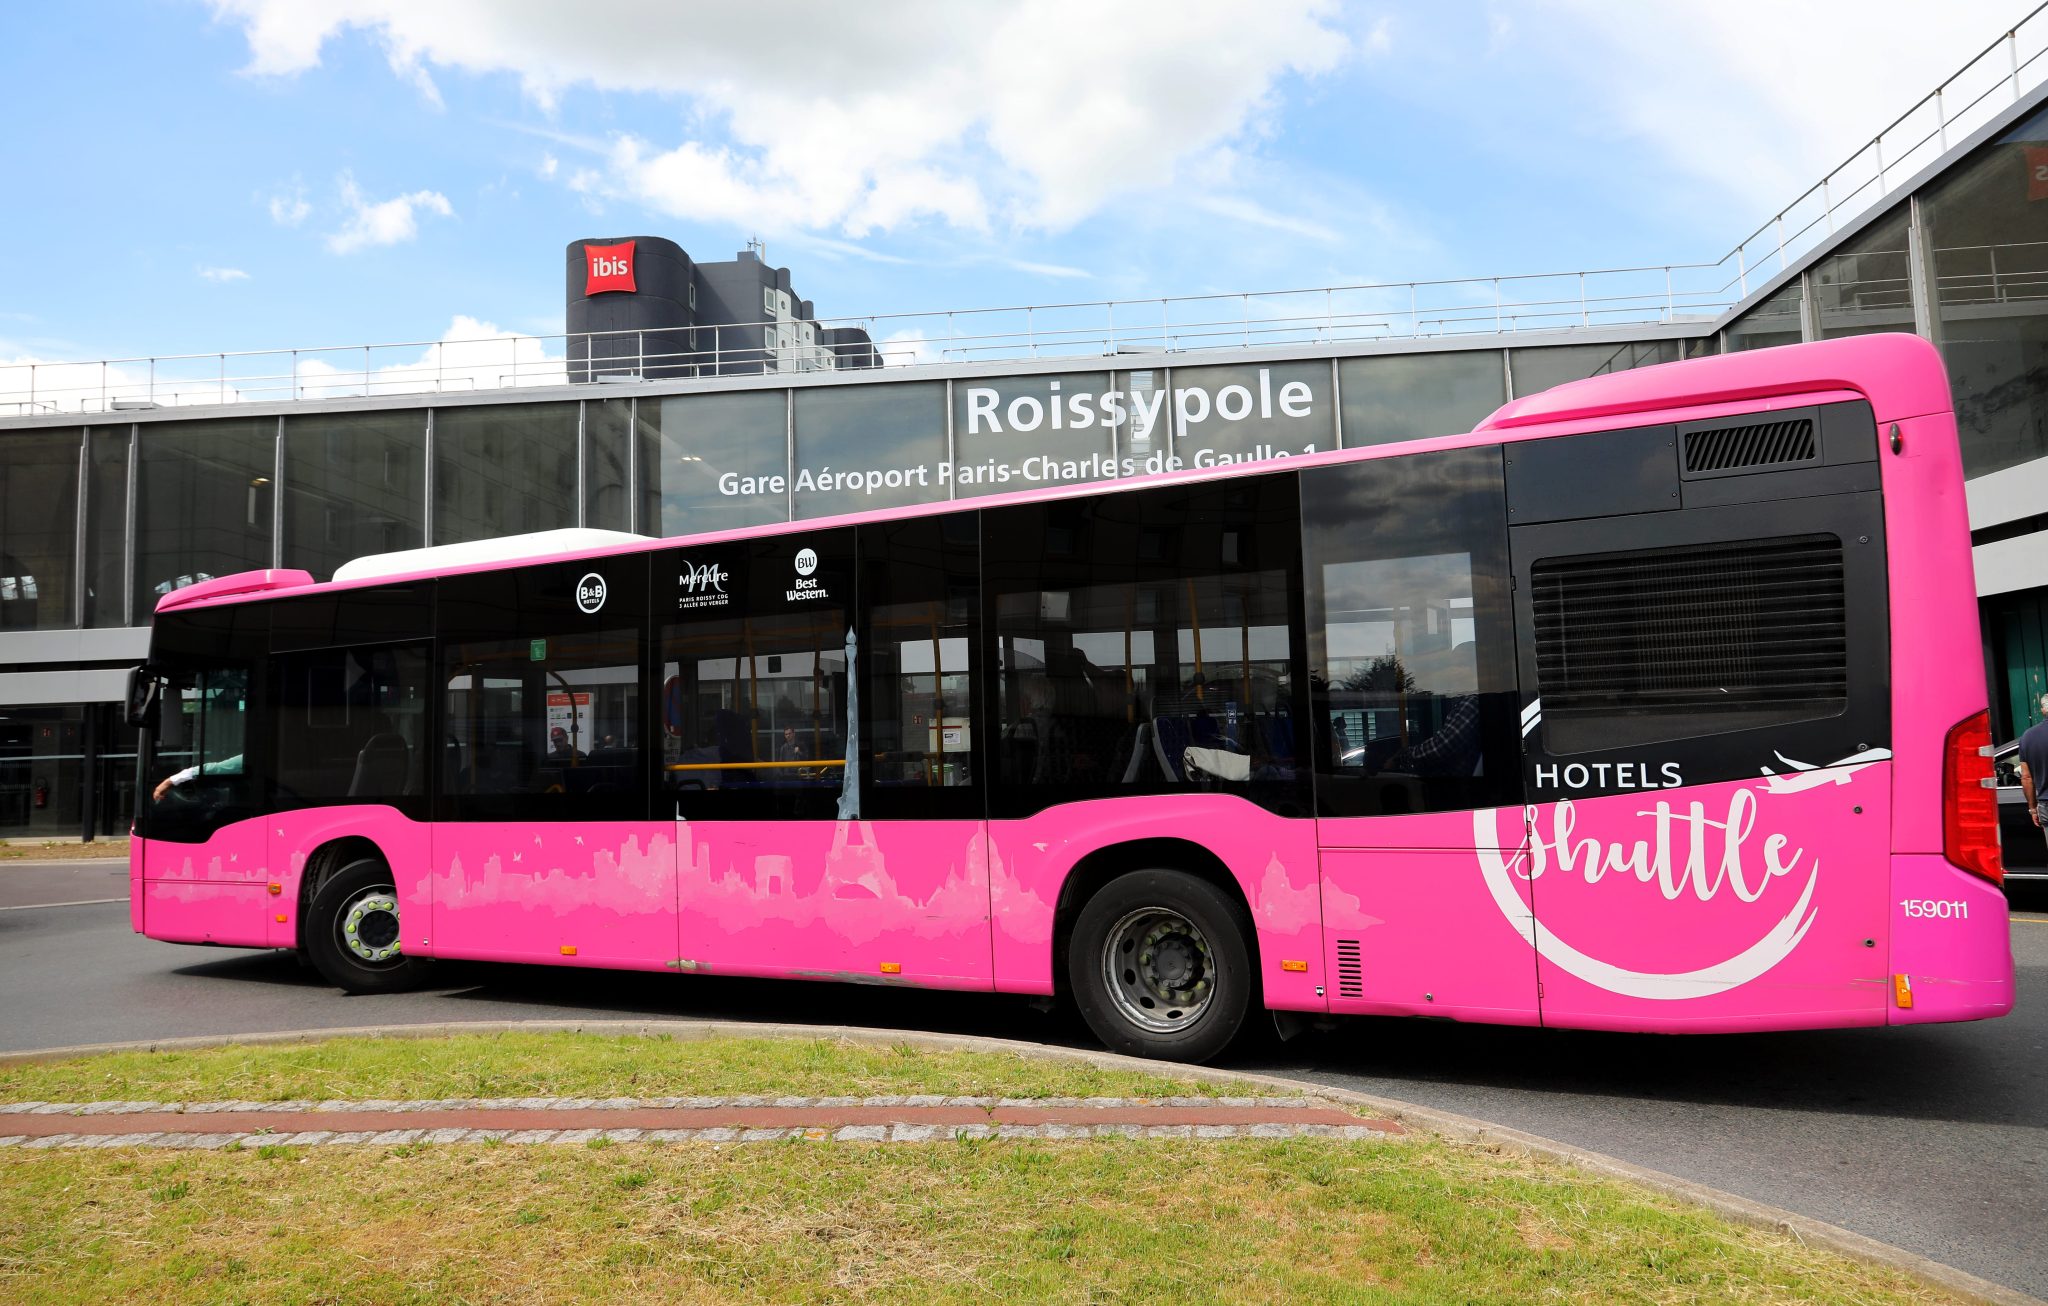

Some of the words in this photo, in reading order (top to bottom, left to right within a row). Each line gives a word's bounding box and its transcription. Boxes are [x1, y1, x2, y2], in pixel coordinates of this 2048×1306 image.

[593, 256, 628, 277] ibis
[967, 368, 1314, 439] Roissypole
[718, 472, 785, 496] Gare
[794, 466, 928, 495] Aéroport
[938, 452, 1136, 486] Paris-Charles
[1145, 449, 1183, 475] de
[797, 556, 815, 569] BW
[679, 572, 729, 586] Mercure
[795, 577, 818, 590] Best
[580, 584, 603, 600] B&B
[583, 597, 600, 605] HOTELS
[1535, 762, 1683, 789] HOTELS
[1899, 899, 1968, 919] 159011
